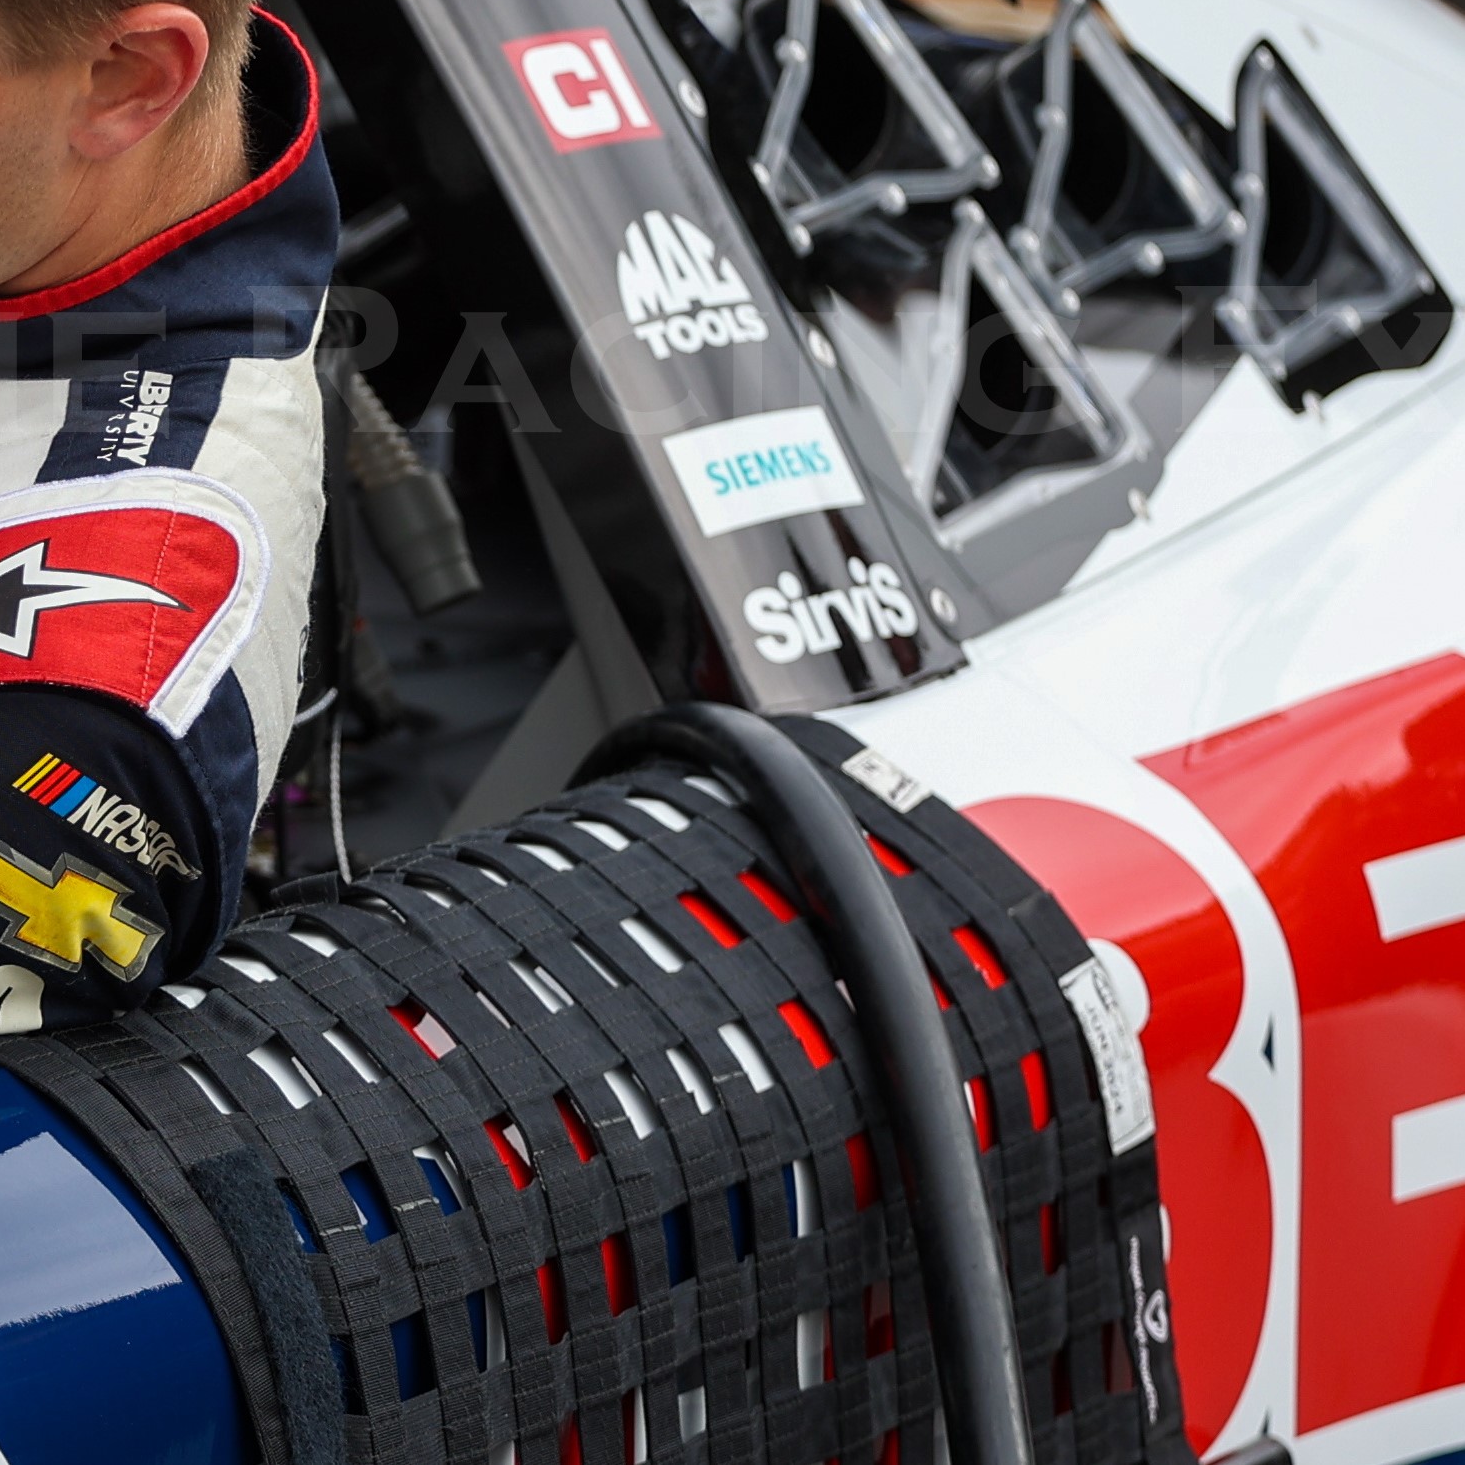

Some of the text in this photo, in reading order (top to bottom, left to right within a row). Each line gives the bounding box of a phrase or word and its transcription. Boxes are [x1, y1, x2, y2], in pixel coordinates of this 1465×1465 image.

[616, 210, 753, 326] MAC
[634, 302, 769, 360] TOOLS
[705, 440, 834, 497] SIEMENS
